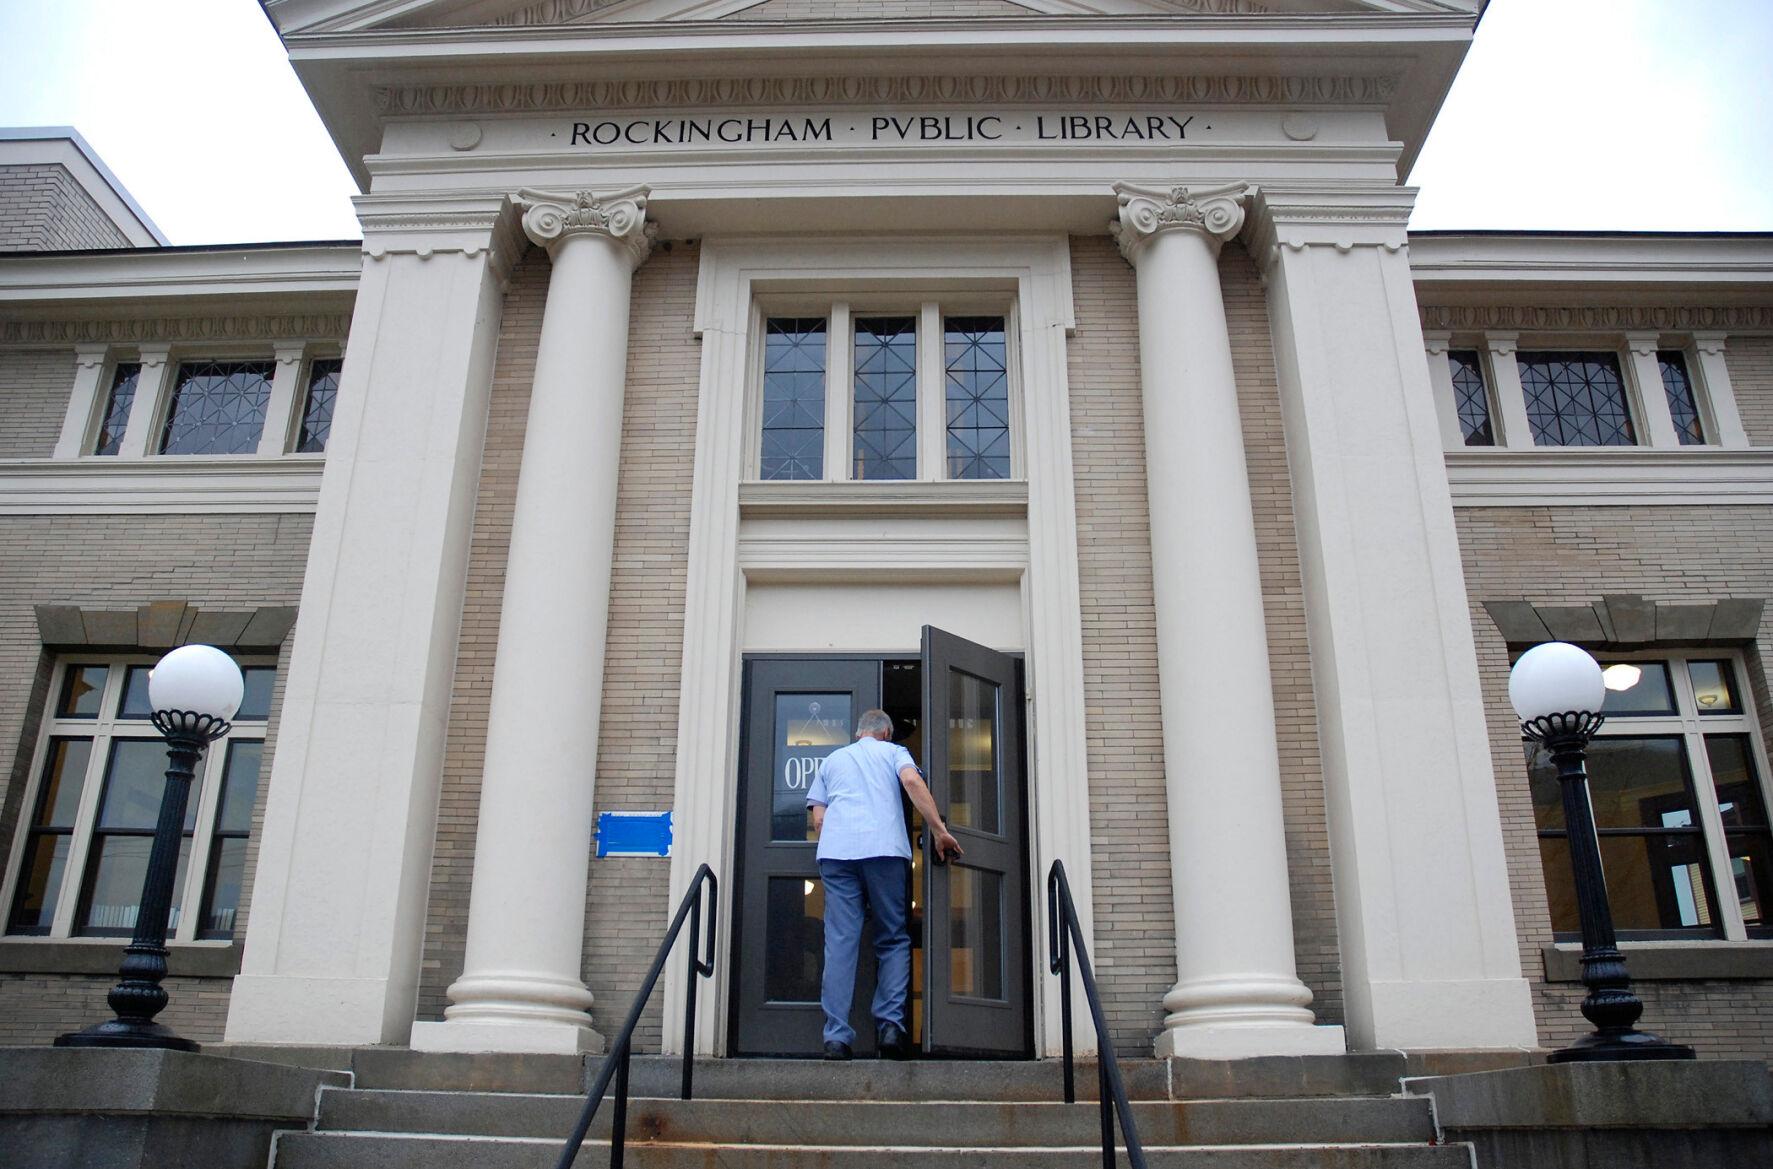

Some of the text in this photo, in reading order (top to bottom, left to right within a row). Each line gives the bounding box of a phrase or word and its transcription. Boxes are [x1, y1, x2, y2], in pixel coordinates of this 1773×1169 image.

[570, 115, 1195, 146] ROCKINGHAM PVBLIC LIBRARY
